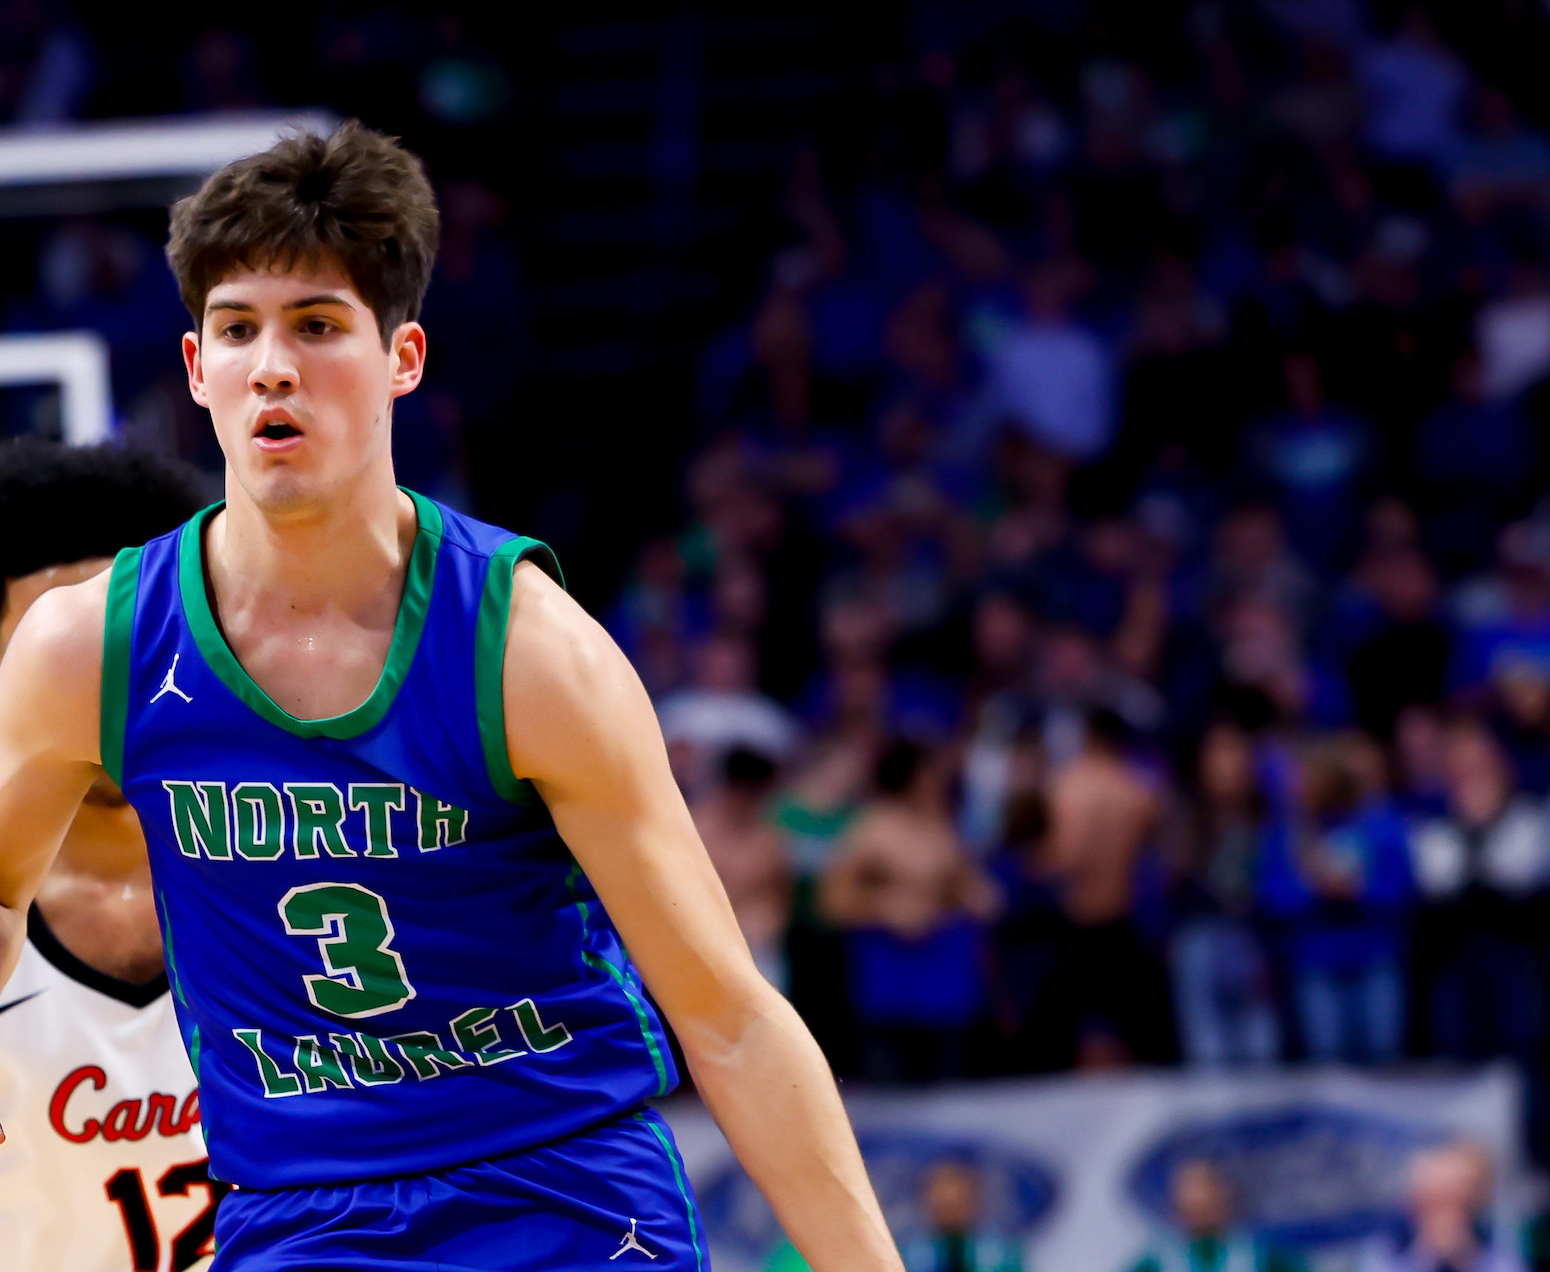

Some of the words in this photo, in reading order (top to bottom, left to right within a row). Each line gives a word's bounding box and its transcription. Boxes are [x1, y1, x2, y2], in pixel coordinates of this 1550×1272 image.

[161, 779, 469, 861] NORTH
[277, 881, 417, 1019] 3
[232, 997, 573, 1099] LAUREL
